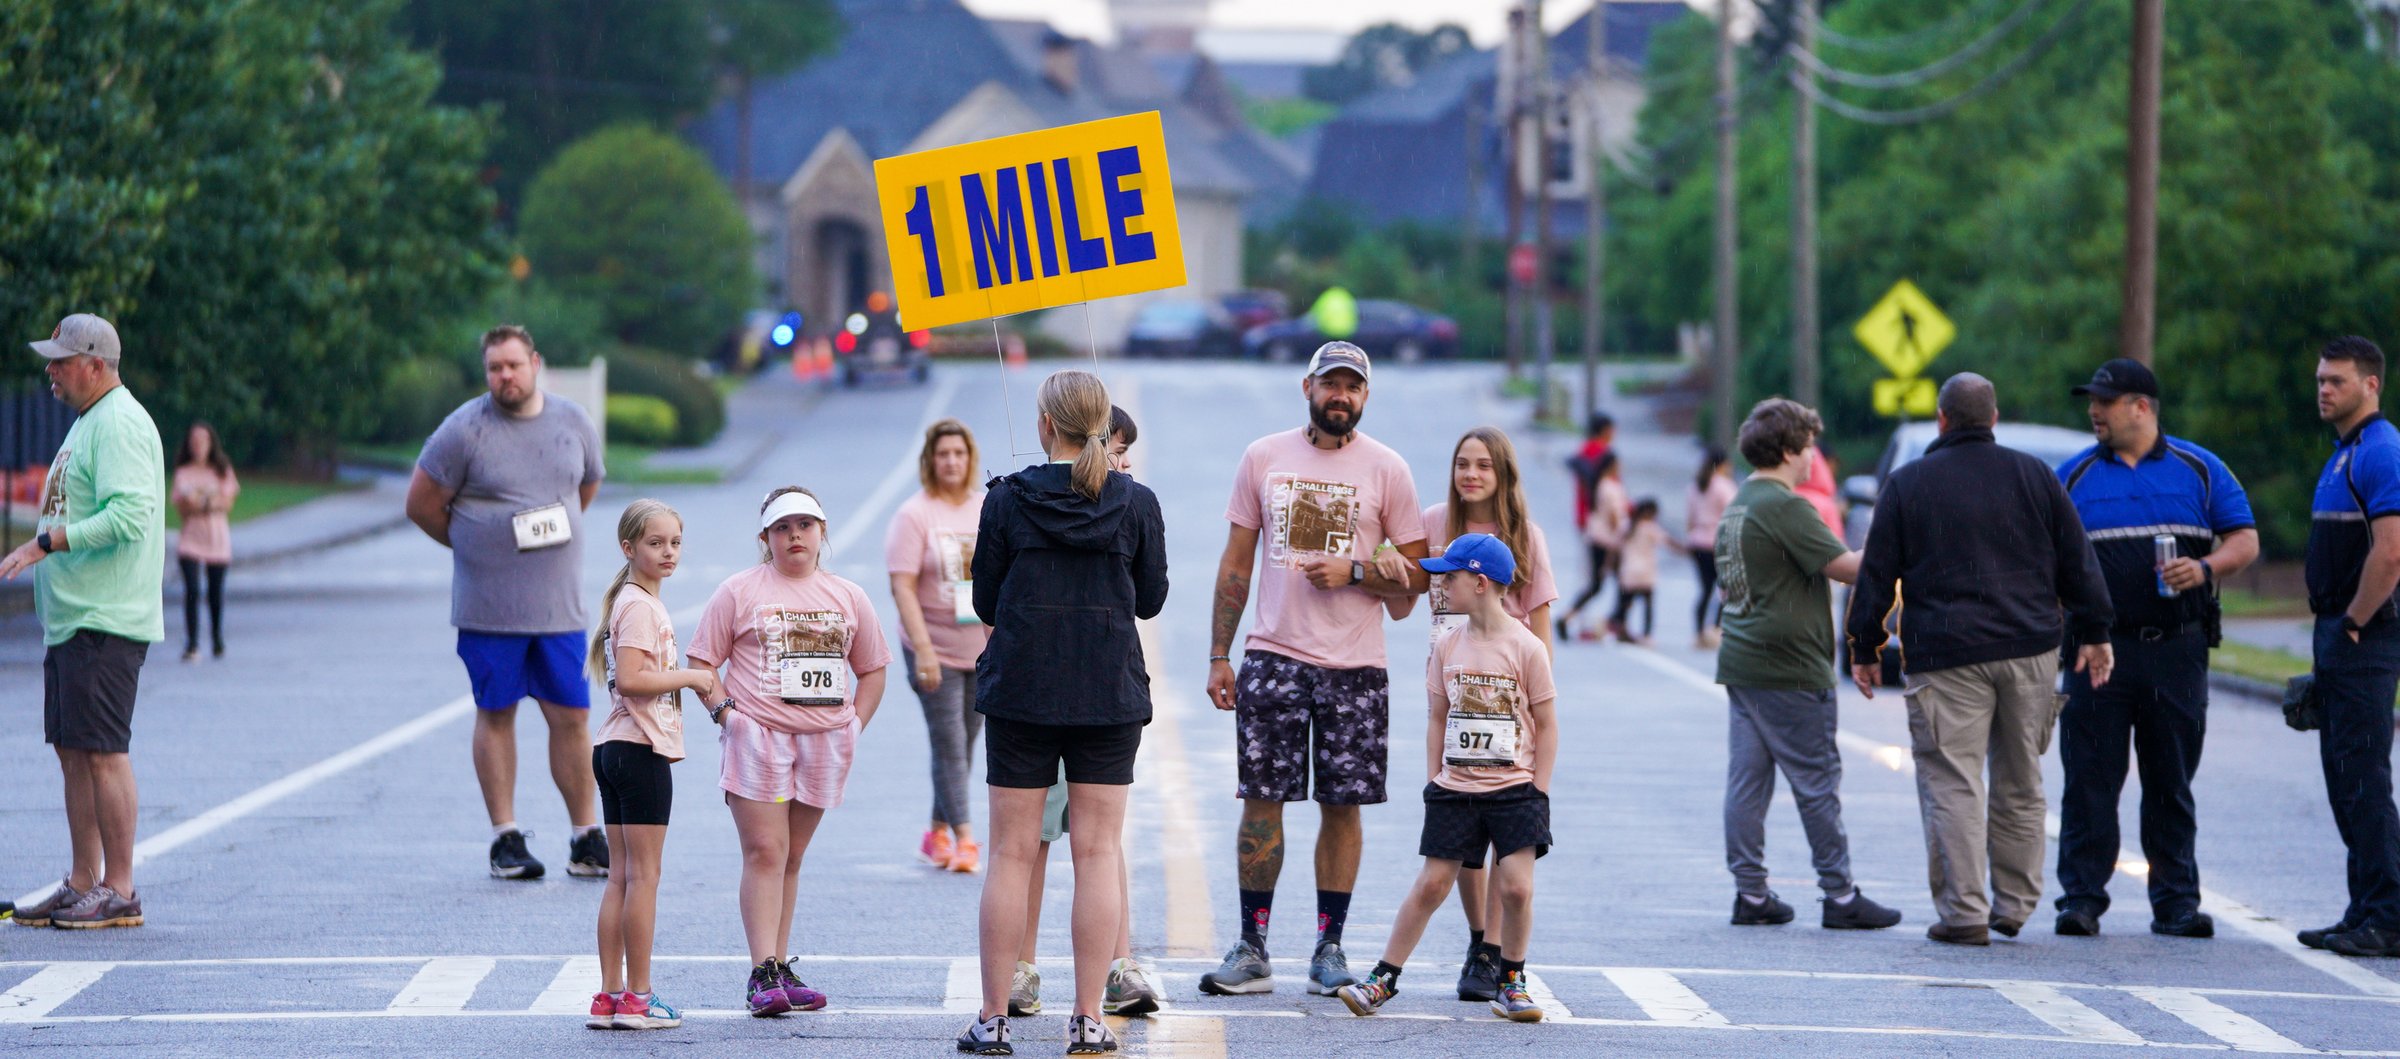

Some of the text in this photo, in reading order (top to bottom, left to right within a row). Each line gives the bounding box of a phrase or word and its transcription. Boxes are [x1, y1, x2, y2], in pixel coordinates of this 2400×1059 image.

[905, 145, 1157, 298] 1 MILE
[1294, 482, 1355, 496] CHALLENGE
[532, 520, 557, 536] 976
[785, 612, 844, 622] CHALLENGE
[801, 670, 832, 688] 978
[1461, 674, 1516, 689] CHALLENGE
[1459, 731, 1493, 749] 977
